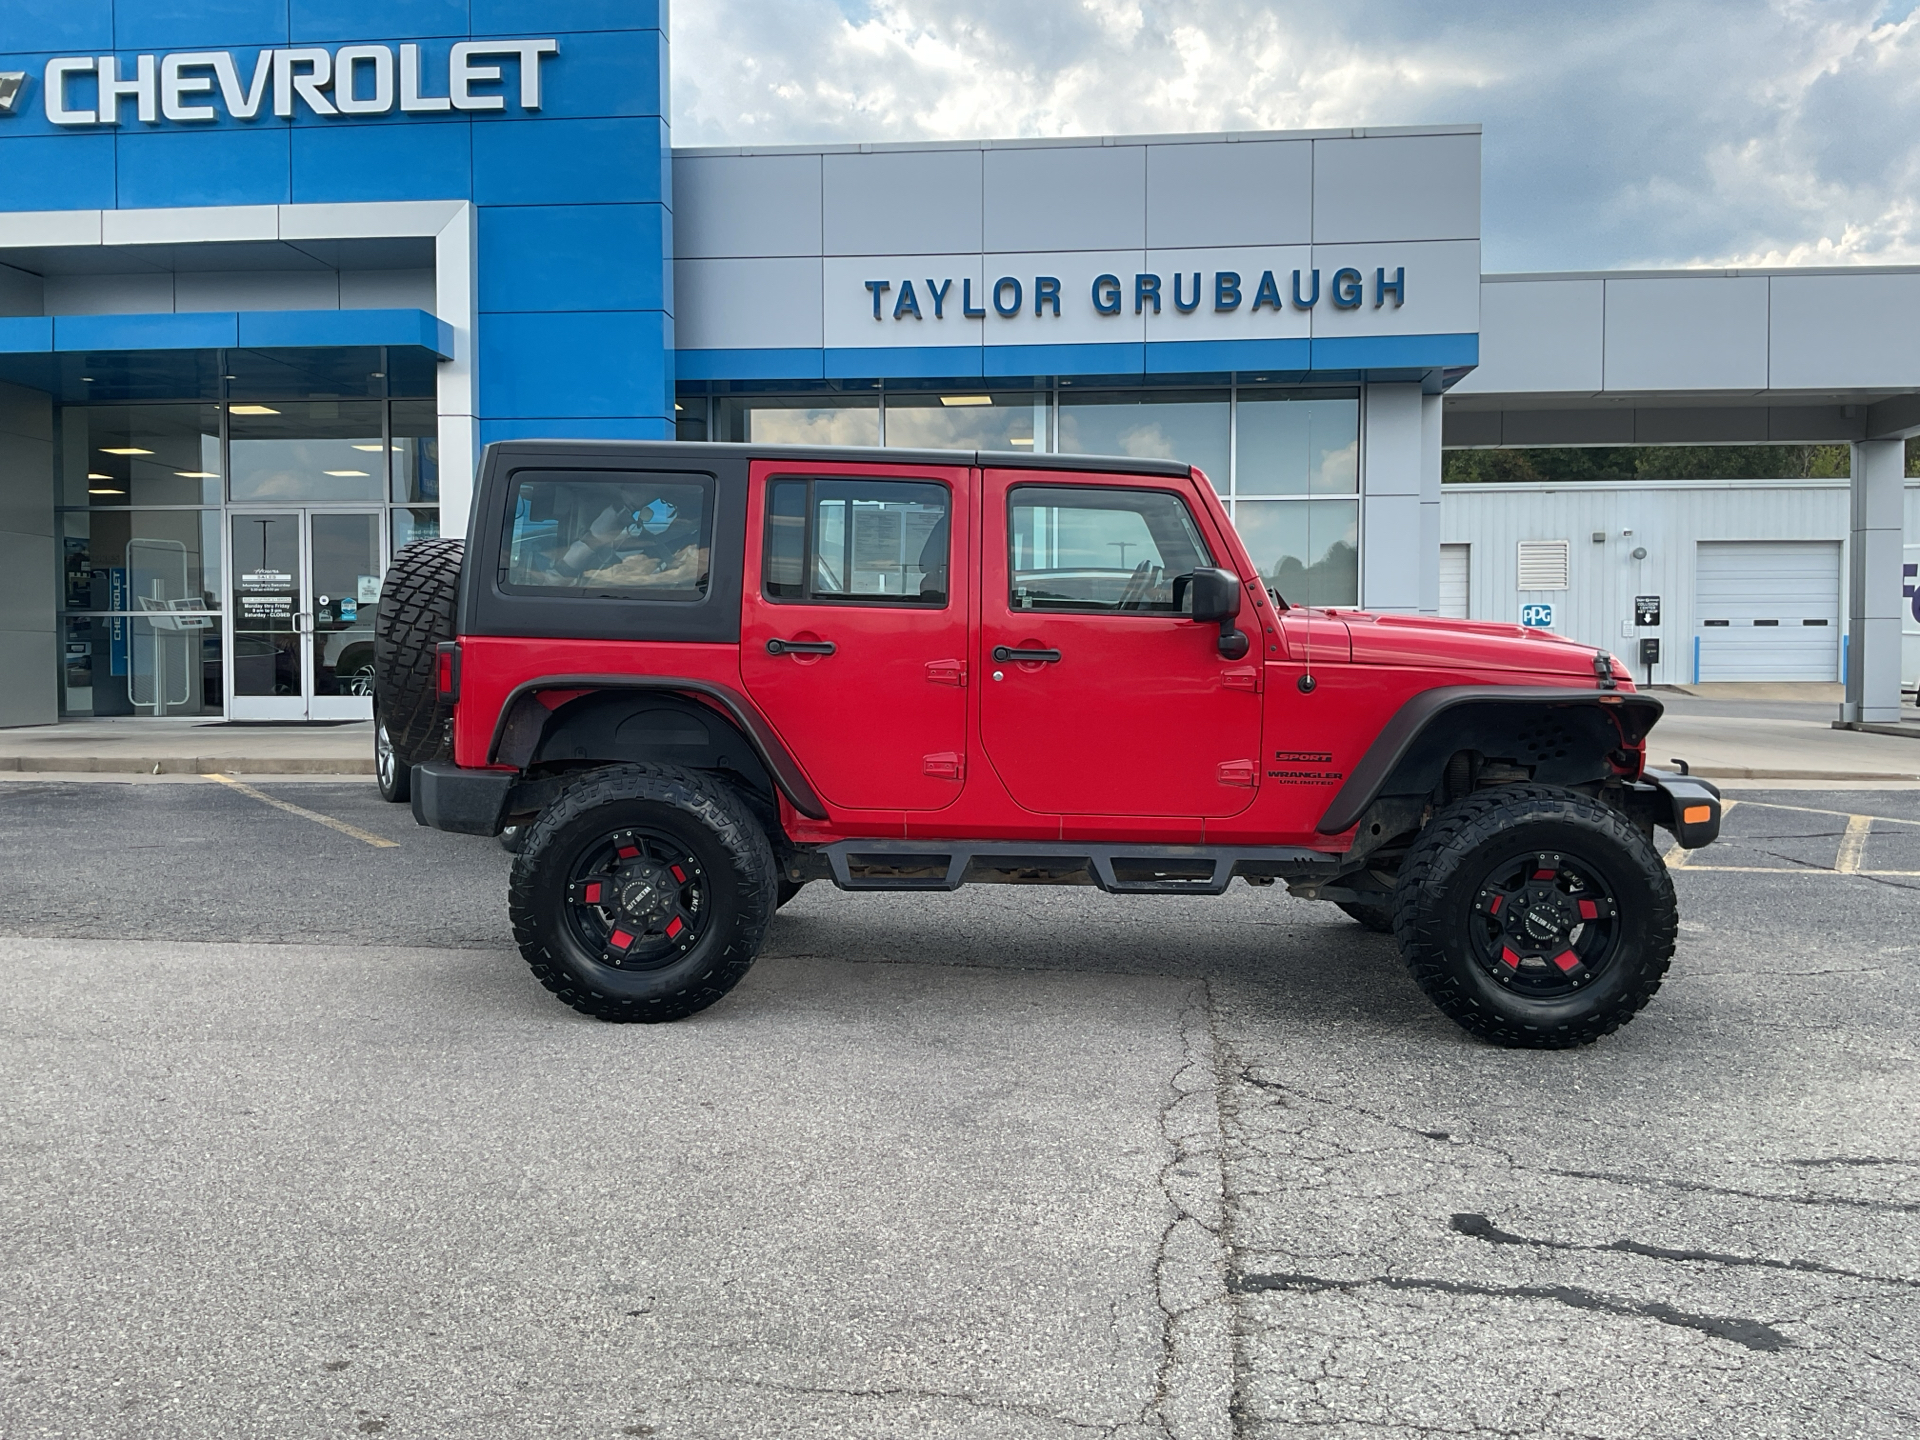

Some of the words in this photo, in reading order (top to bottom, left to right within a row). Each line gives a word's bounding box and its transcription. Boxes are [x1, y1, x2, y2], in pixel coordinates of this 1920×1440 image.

[45, 38, 559, 127] CHEVROLET
[865, 275, 1062, 321] TAYLOR
[1092, 266, 1406, 316] GRUBAUGH
[1523, 606, 1551, 625] PPG
[1276, 753, 1332, 761] SPORT
[1268, 771, 1343, 780] WRANGLER
